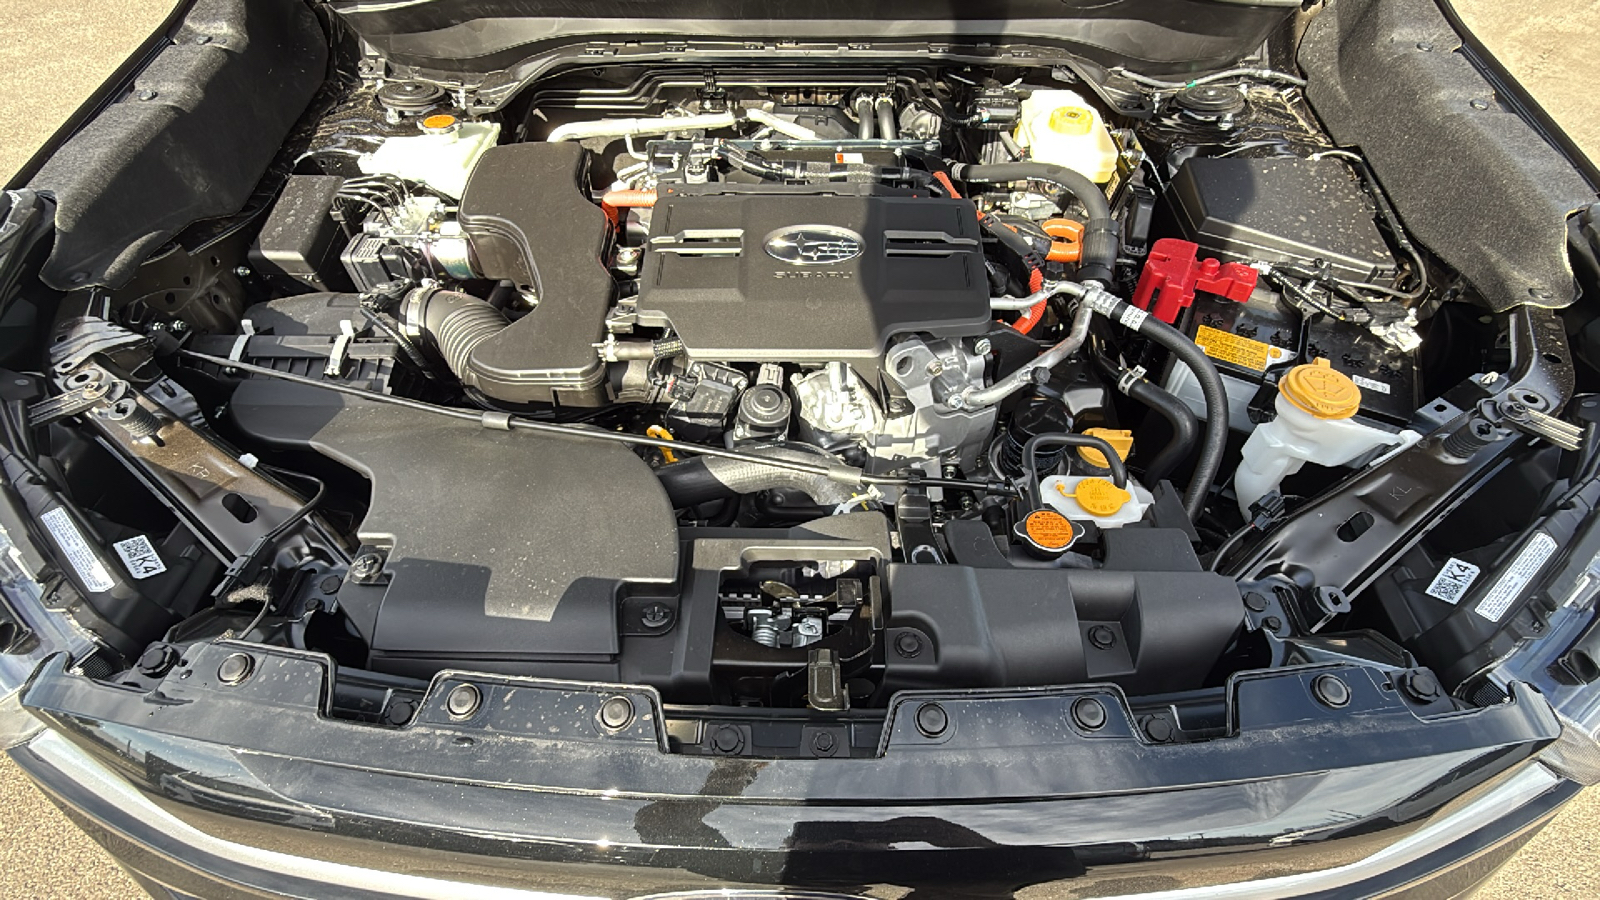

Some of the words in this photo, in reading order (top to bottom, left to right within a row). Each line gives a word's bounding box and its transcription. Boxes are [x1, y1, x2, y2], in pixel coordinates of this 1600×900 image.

[773, 271, 853, 279] SUBARU
[1387, 485, 1413, 501] KL
[135, 553, 158, 574] K4
[1446, 563, 1471, 582] K4
